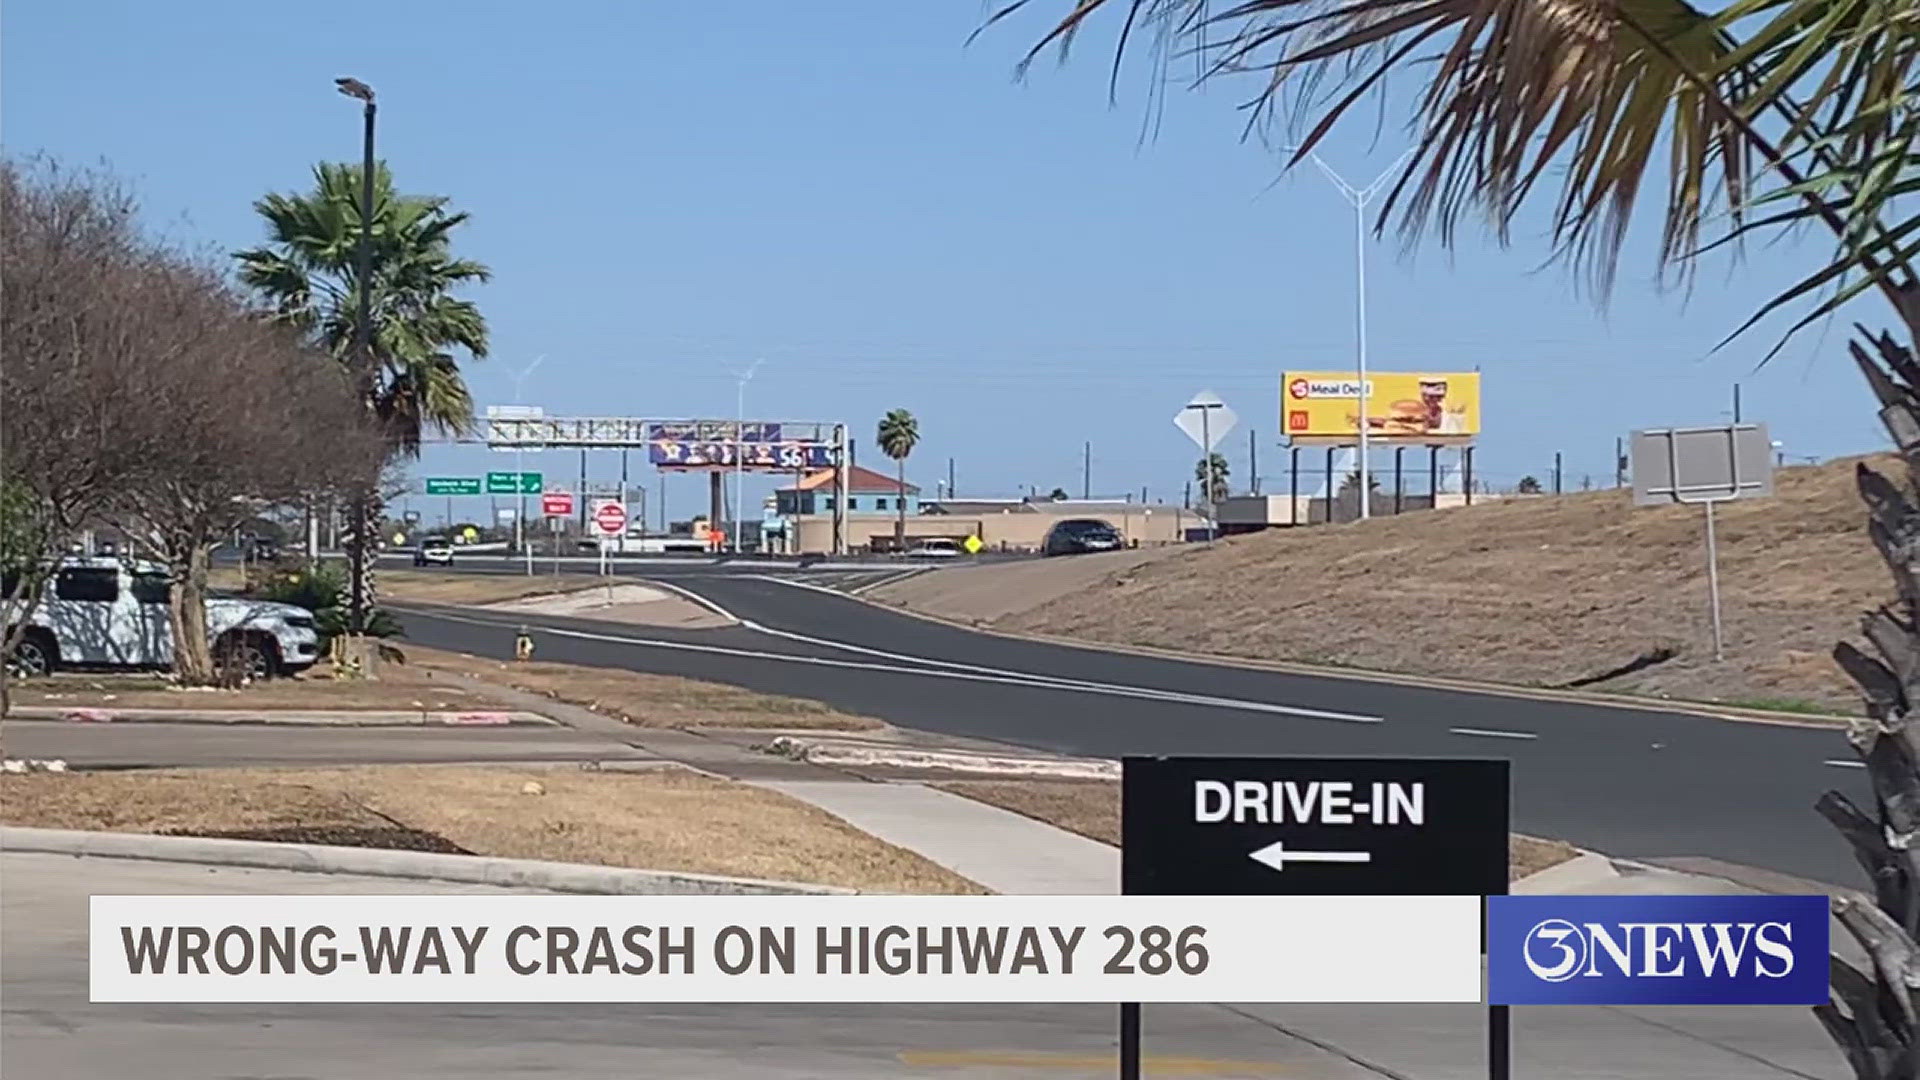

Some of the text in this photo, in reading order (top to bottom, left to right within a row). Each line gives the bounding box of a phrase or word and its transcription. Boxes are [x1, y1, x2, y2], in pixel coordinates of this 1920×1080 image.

[1311, 384, 1339, 394] Meal
[1342, 383, 1370, 395] Del
[1195, 780, 1425, 825] DRIVE-IN
